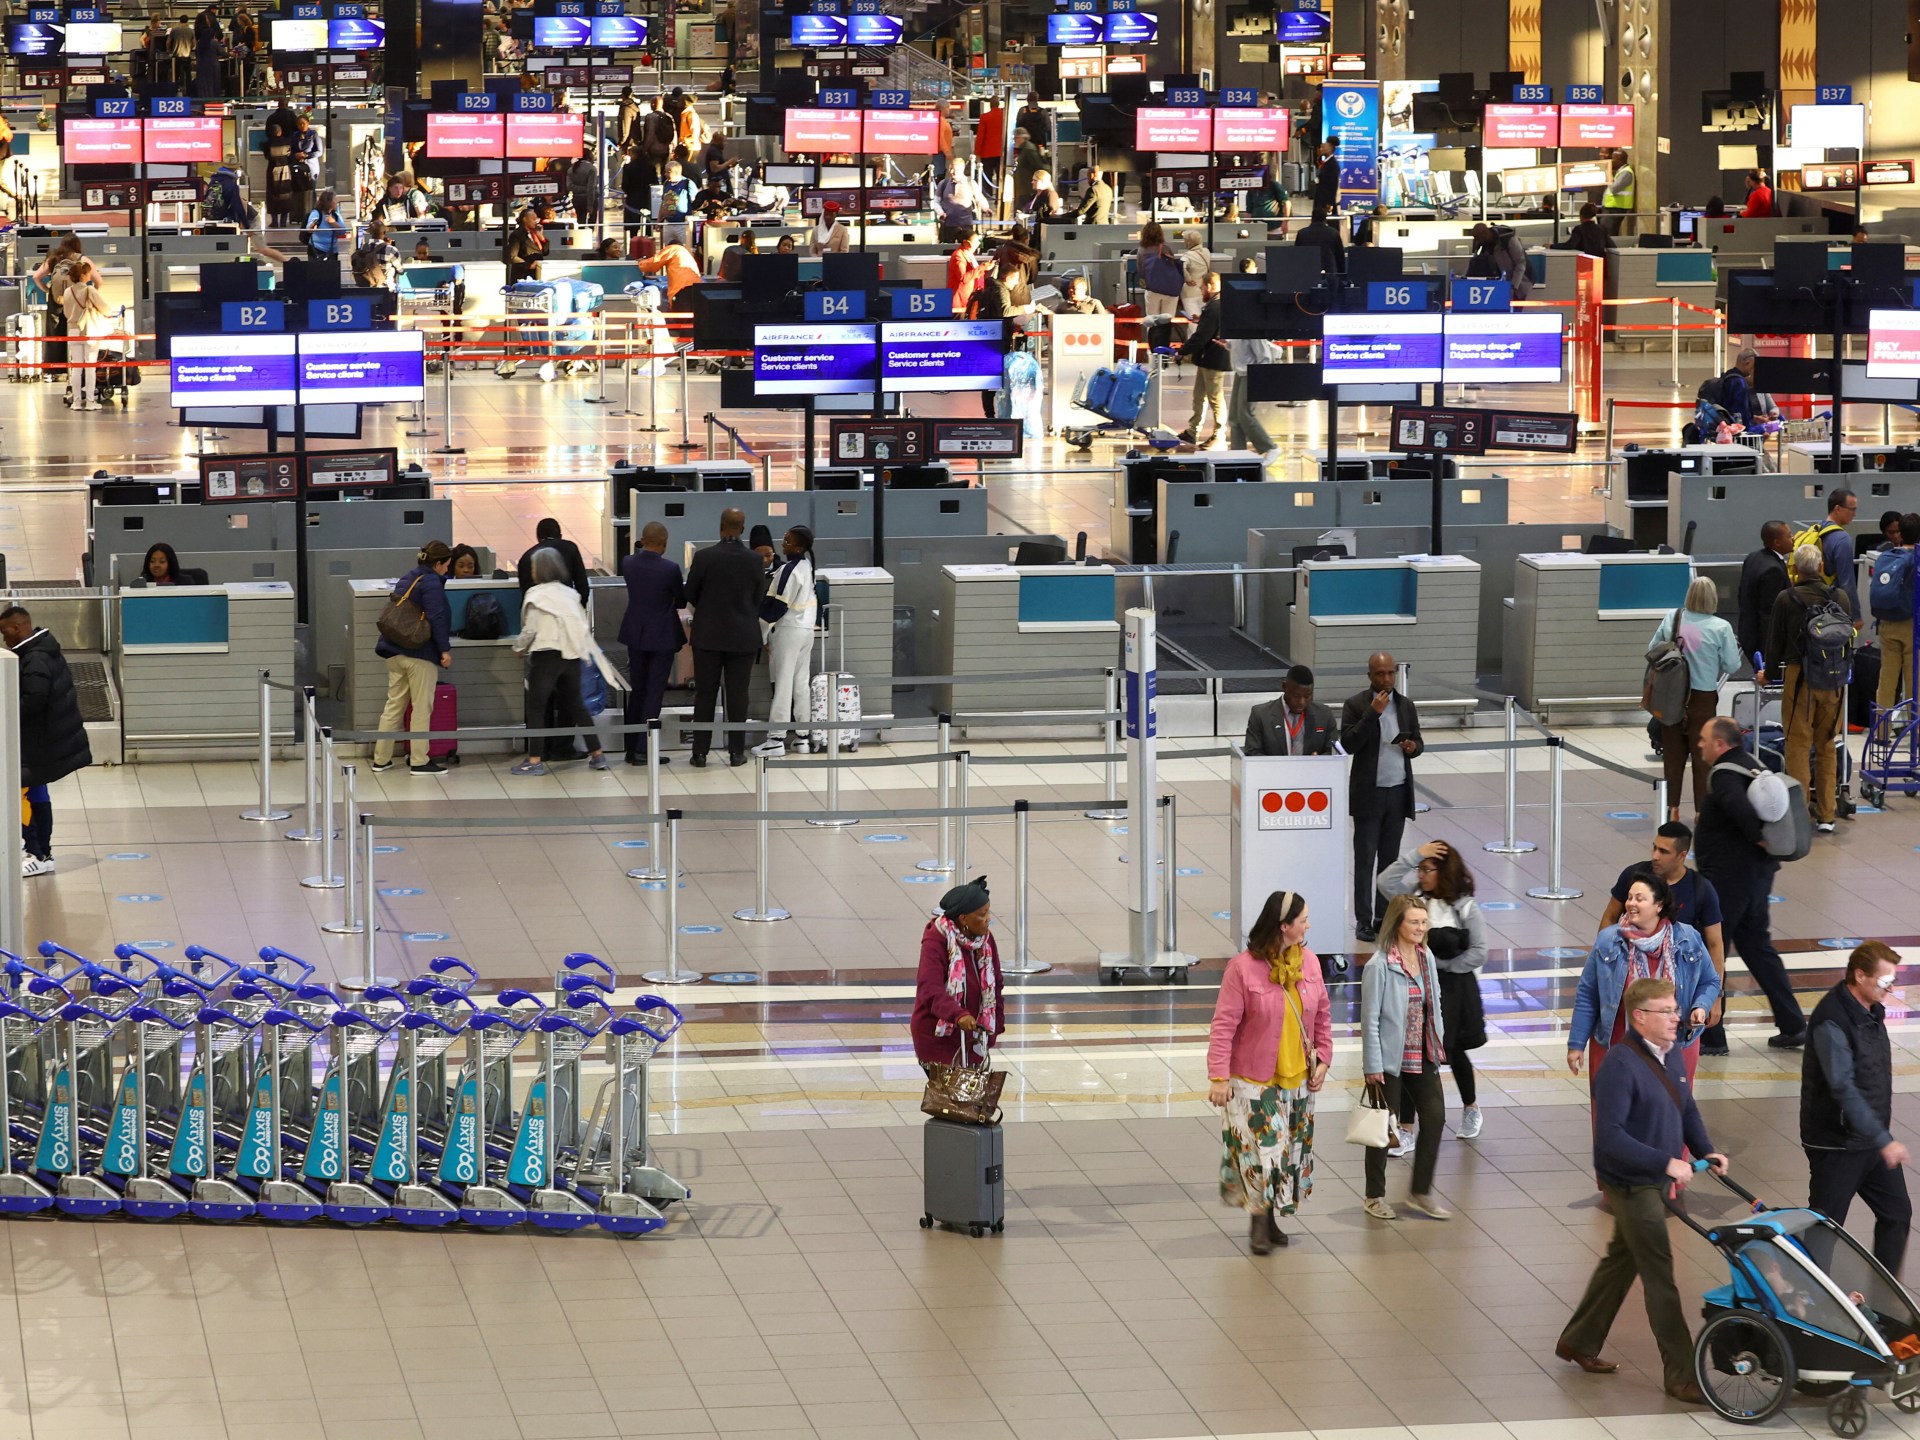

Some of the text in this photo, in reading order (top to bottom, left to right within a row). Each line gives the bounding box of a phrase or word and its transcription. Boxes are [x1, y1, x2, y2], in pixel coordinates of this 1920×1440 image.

[561, 4, 580, 14] B56
[601, 4, 620, 14] B57
[817, 3, 836, 12] B58
[856, 3, 876, 12] B59
[1074, 1, 1093, 11] B60
[1112, 0, 1131, 10] B61
[1298, 0, 1317, 9] B62
[35, 11, 54, 21] B52
[75, 11, 95, 20] B53
[298, 7, 318, 17] B54
[338, 6, 358, 16] B55
[825, 92, 849, 104] B31
[879, 93, 904, 105] B32
[1174, 91, 1199, 103] B33
[1227, 91, 1252, 103] B34
[1520, 88, 1545, 99] B35
[1572, 88, 1597, 99] B36
[1822, 88, 1846, 100] B37
[103, 101, 129, 114] B27
[158, 100, 185, 113] B28
[464, 96, 490, 109] B29
[520, 96, 546, 109] B30
[1385, 286, 1411, 305] B6
[1469, 286, 1496, 305] B7
[822, 296, 849, 315] B4
[910, 294, 936, 313] B5
[240, 306, 267, 326] B2
[326, 304, 354, 323] B3
[1874, 342, 1900, 351] SKY
[888, 350, 961, 359] Customer service
[792, 362, 818, 370] clients
[888, 359, 944, 367] Service clients
[178, 374, 208, 382] Service
[306, 371, 336, 379] Service
[1263, 815, 1328, 826] SECURITAS
